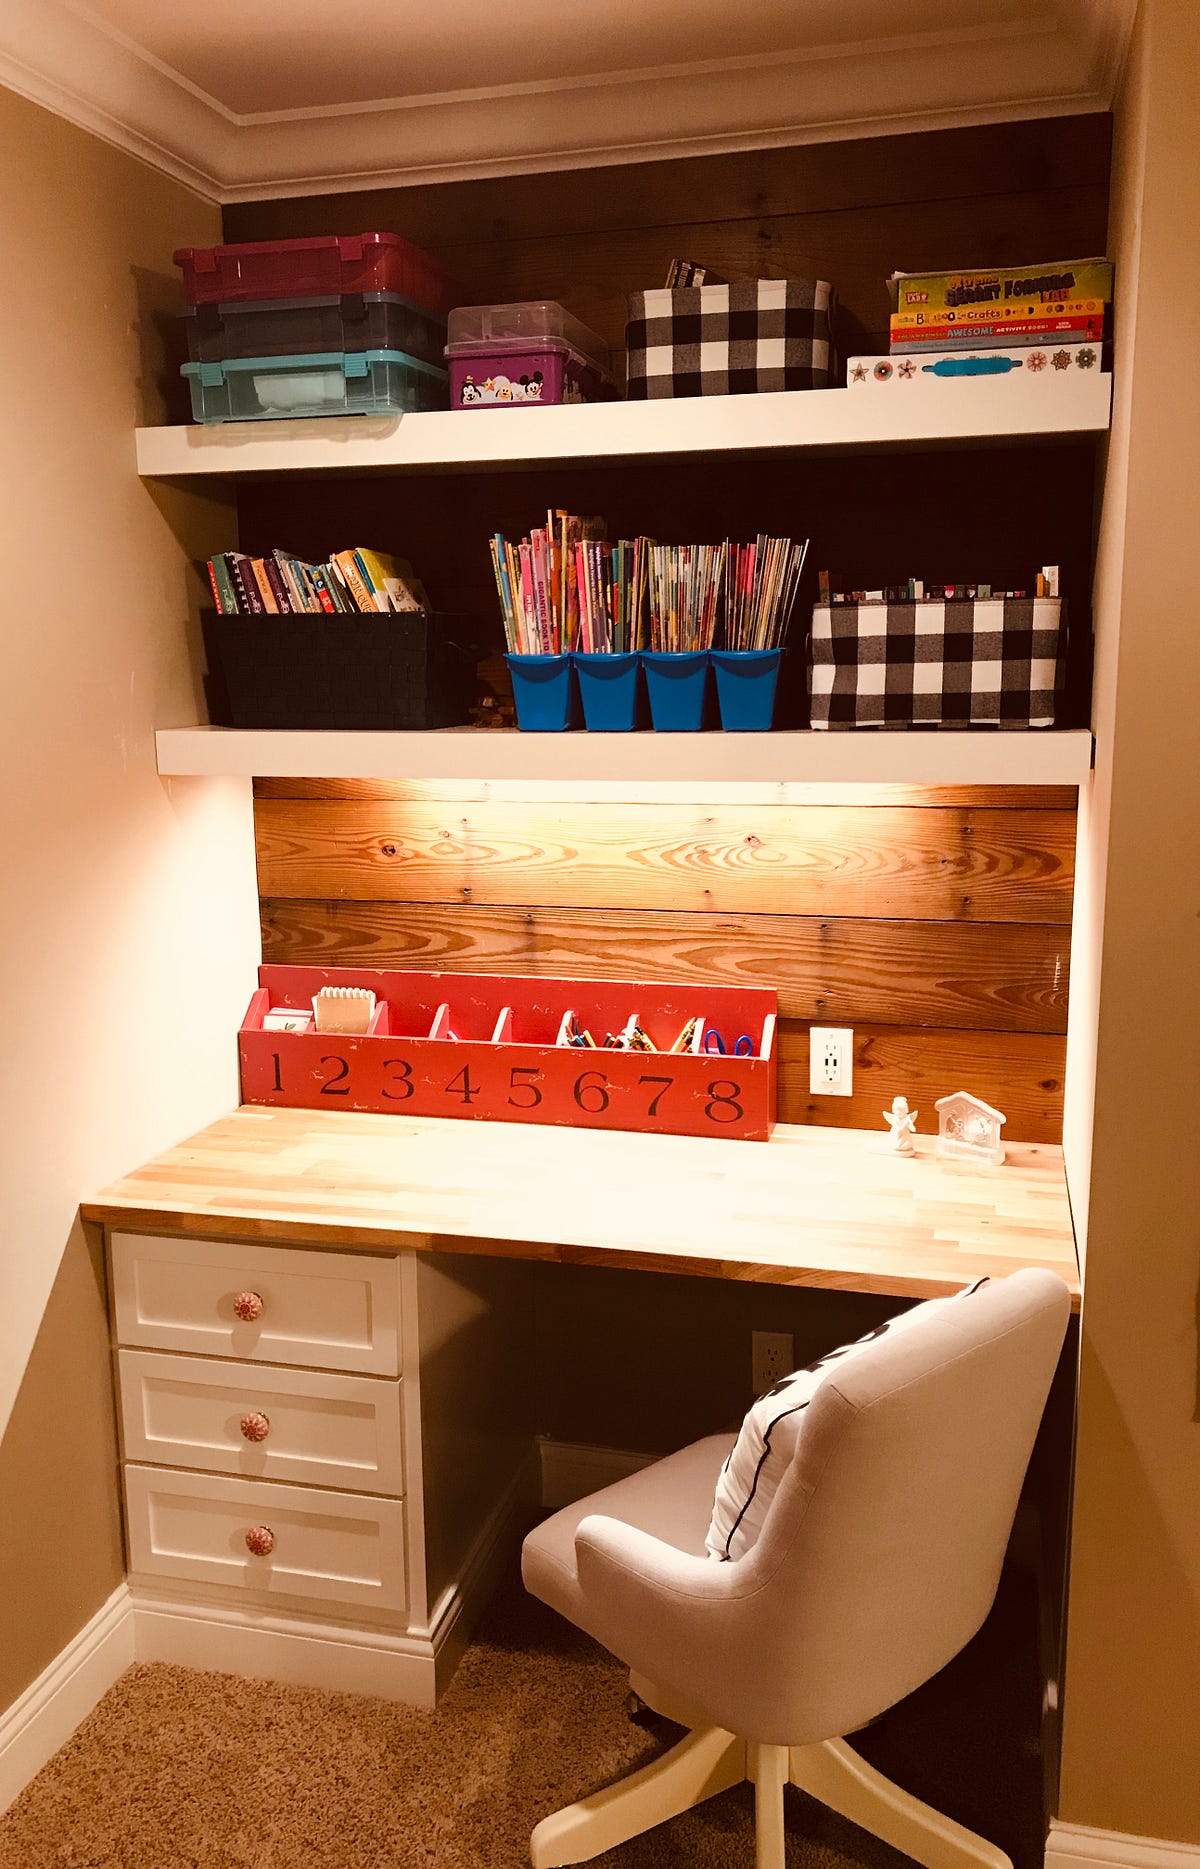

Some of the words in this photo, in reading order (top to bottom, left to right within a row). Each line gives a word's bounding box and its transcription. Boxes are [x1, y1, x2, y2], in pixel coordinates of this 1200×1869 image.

[967, 310, 1001, 319] Crafts
[947, 326, 994, 338] AWESOME
[538, 581, 546, 618] GIGANTIC
[271, 1053, 285, 1092] 1
[320, 1055, 350, 1096] 2
[381, 1059, 415, 1100] 3
[445, 1064, 480, 1104] 4
[508, 1067, 542, 1109] 5
[573, 1071, 609, 1113] 6
[638, 1075, 674, 1117] 7
[704, 1080, 744, 1123] 8
